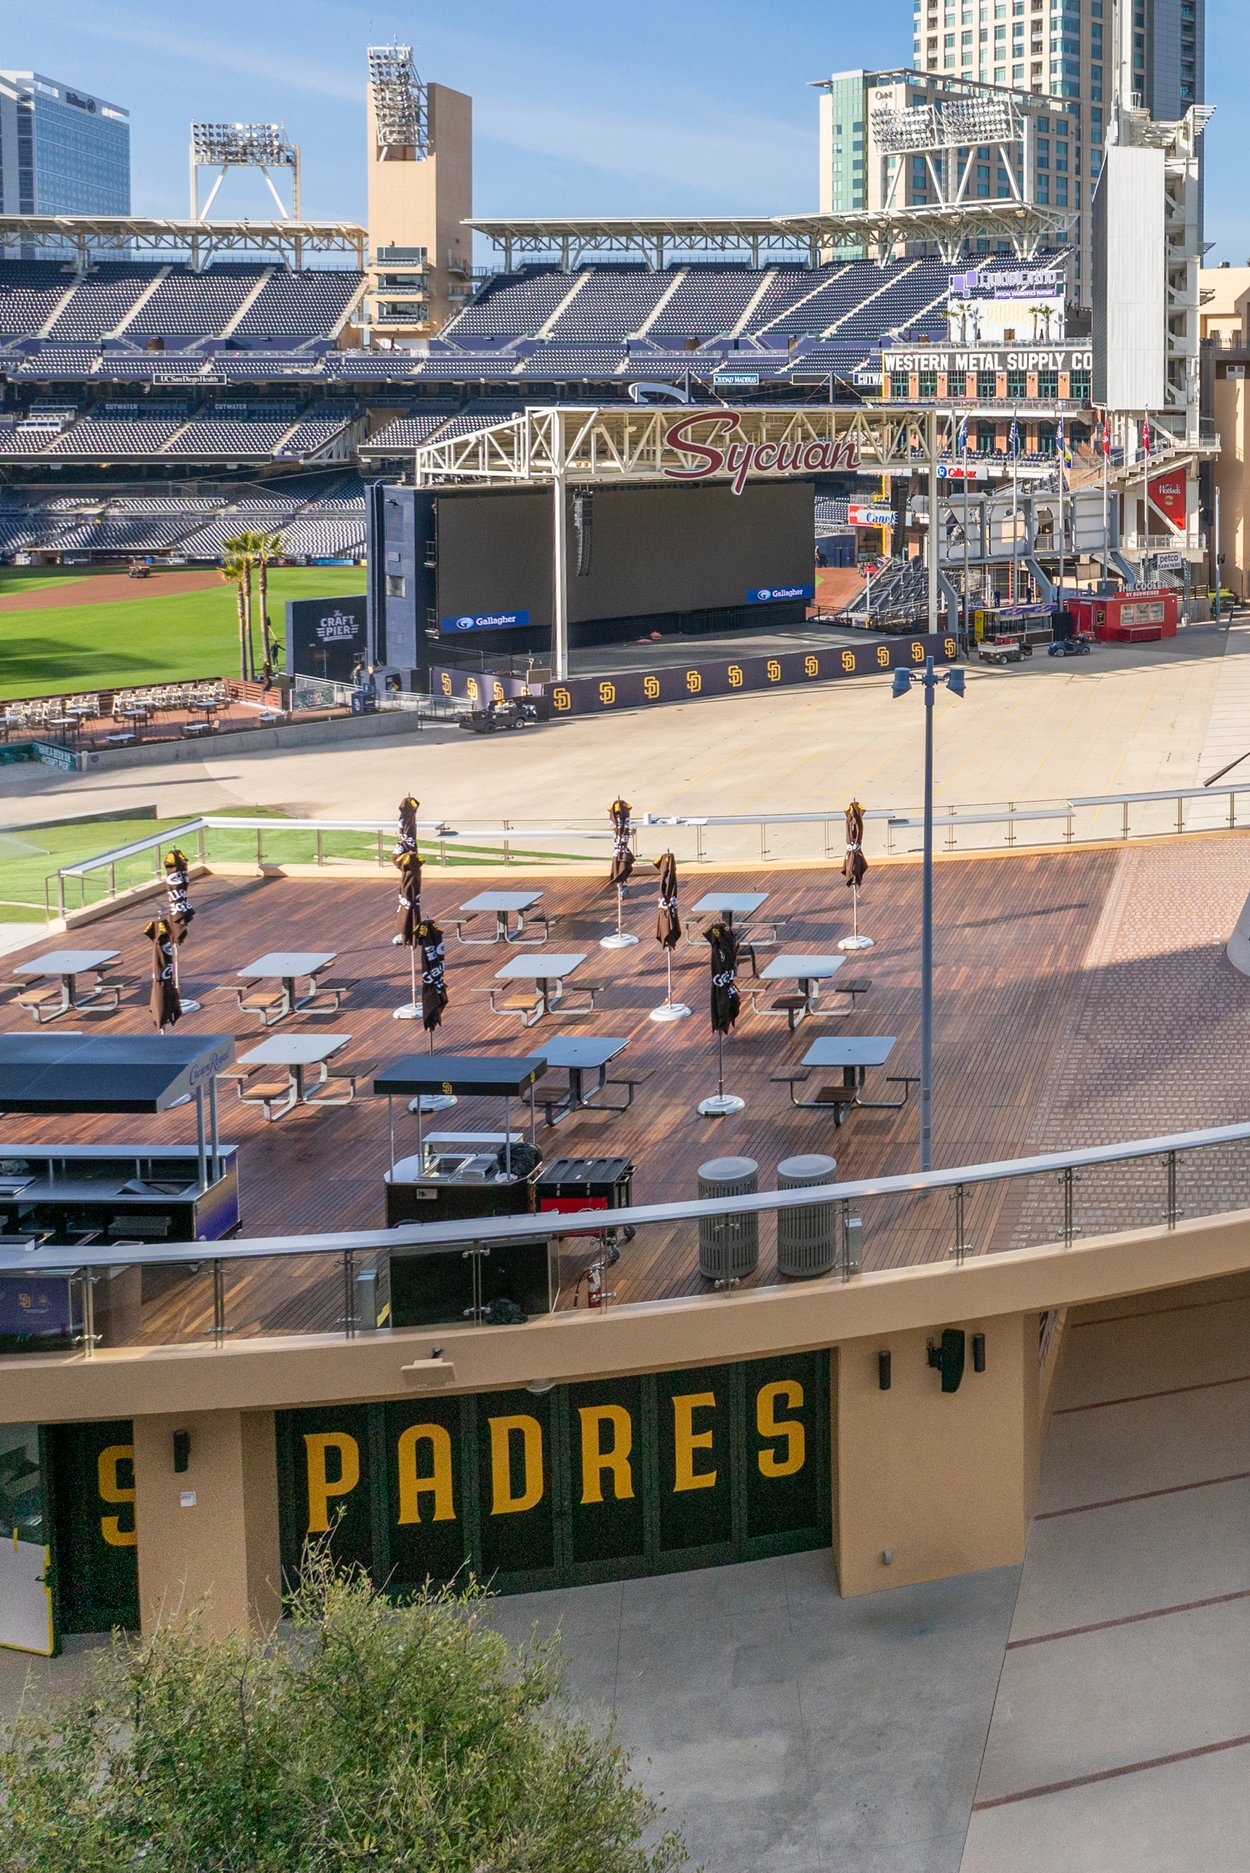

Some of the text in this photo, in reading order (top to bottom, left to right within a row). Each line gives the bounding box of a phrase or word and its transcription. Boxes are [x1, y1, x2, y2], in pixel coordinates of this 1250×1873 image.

[885, 353, 949, 371] WESTERN
[955, 353, 1002, 370] METAL
[1007, 353, 1065, 370] SUPPLY
[663, 411, 863, 495] Sycuan
[1159, 554, 1179, 563] petco
[772, 588, 803, 598] Gallagher
[1118, 583, 1134, 592] THE
[320, 615, 355, 627] CRAFT
[475, 614, 516, 627] Gallagher
[325, 625, 351, 636] PIER
[190, 1064, 211, 1085] Crown
[303, 1379, 806, 1533] PADRES
